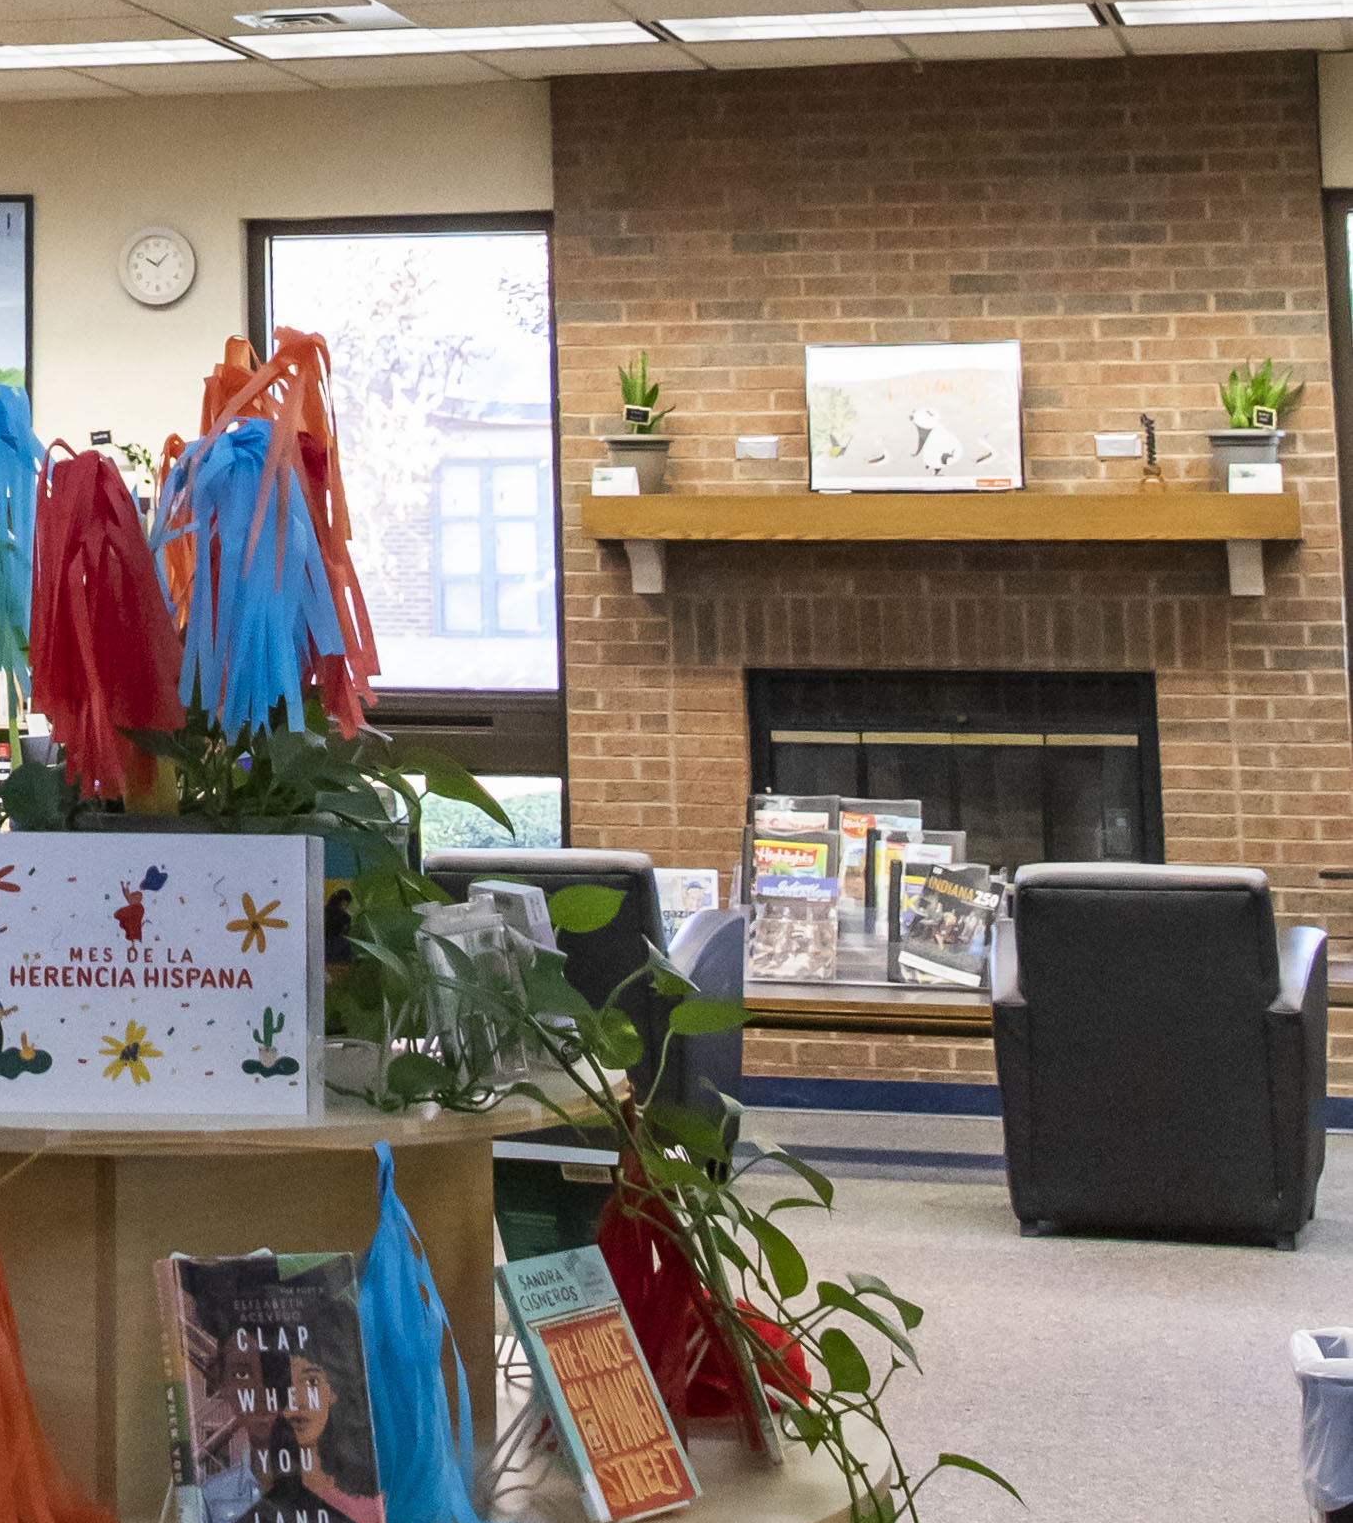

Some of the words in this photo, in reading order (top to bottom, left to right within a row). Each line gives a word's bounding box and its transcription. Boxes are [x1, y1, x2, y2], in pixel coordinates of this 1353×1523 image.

[755, 847, 815, 867] Highlights
[928, 877, 975, 901] INDIANA
[973, 889, 1000, 908] 250
[69, 947, 113, 963] MES
[127, 946, 154, 963] DE
[167, 948, 194, 964] LA
[9, 966, 136, 988] HERENCIA
[143, 968, 254, 990] HISPANA
[517, 1268, 565, 1291] SANDRA
[234, 1299, 304, 1309] ELIZABETH
[519, 1285, 579, 1312] CISNEROS
[239, 1311, 301, 1323] ACEVEDO
[236, 1326, 309, 1352] CLAP
[545, 1337, 585, 1381] THE
[570, 1319, 634, 1377] HOUSE
[237, 1386, 320, 1413] WHEN
[584, 1363, 665, 1454] MANGO
[257, 1447, 313, 1474] YOU
[594, 1439, 683, 1506] STREET
